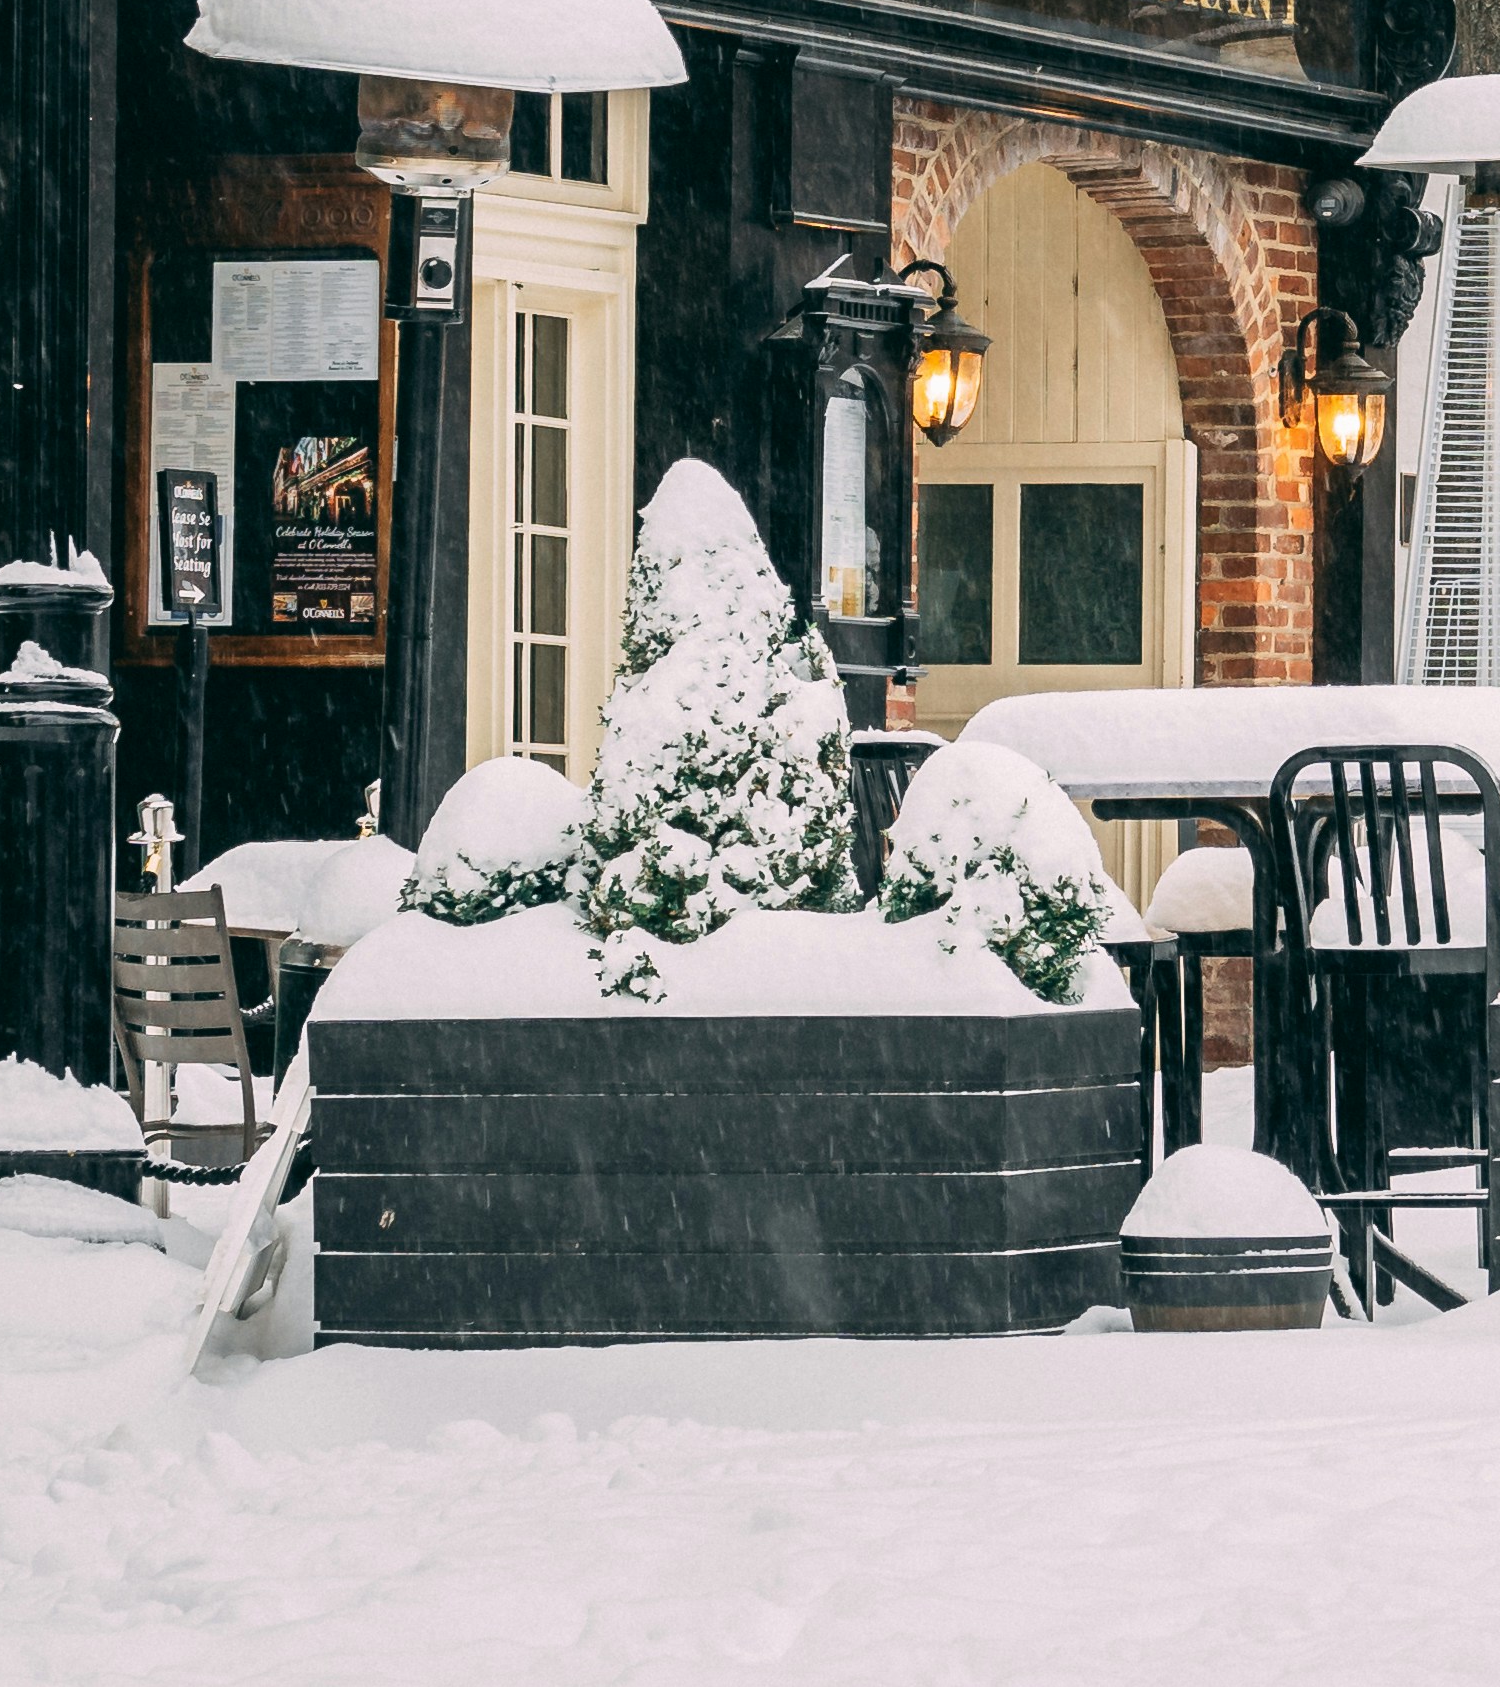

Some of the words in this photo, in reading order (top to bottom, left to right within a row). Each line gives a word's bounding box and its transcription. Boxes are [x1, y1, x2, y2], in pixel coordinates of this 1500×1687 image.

[276, 526, 312, 538] Celebrate
[314, 526, 345, 540] Holiday
[194, 533, 213, 554] for
[173, 556, 212, 579] Seating
[302, 607, 345, 618] O'CONNELL'S
